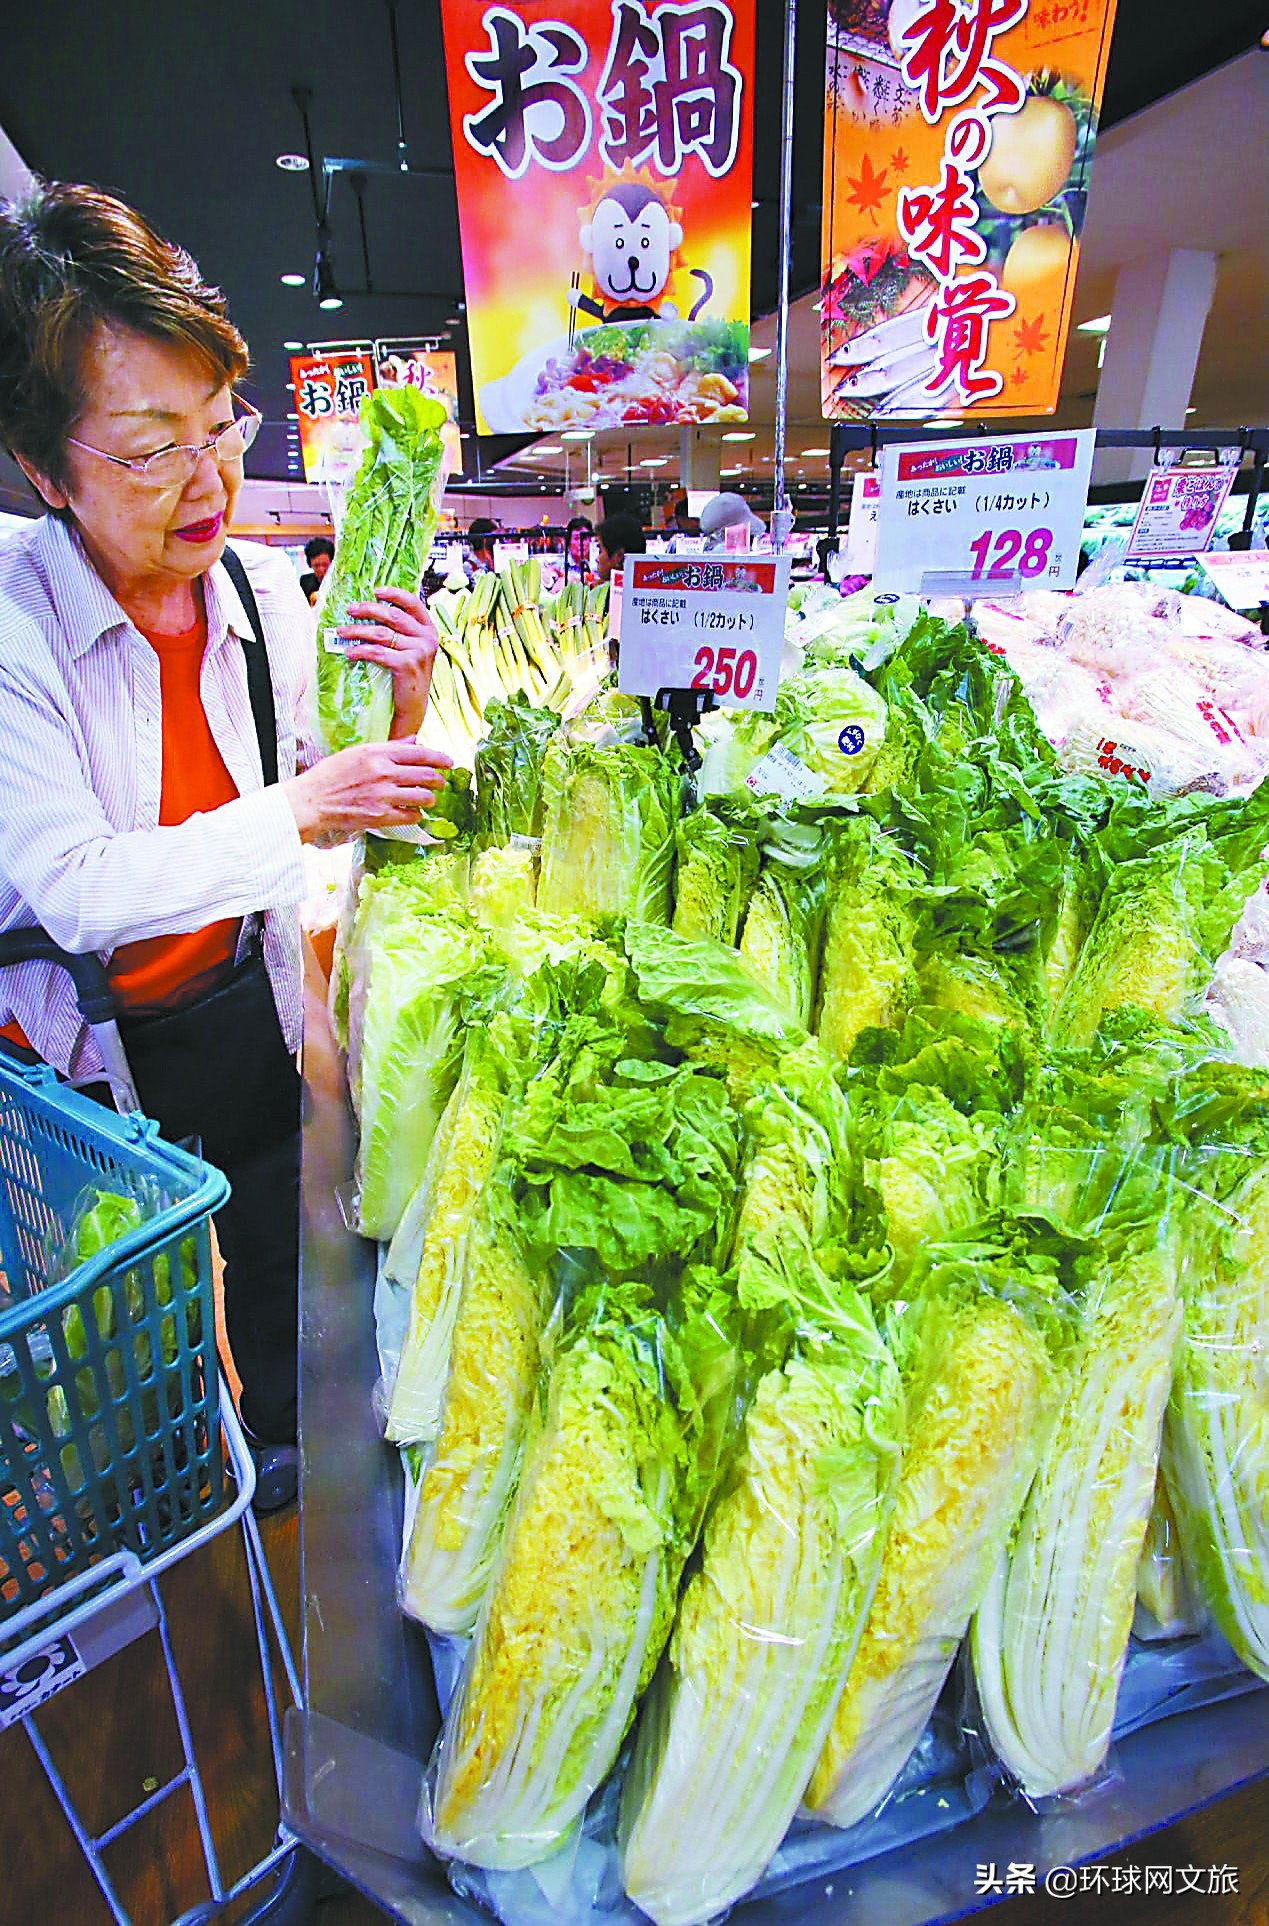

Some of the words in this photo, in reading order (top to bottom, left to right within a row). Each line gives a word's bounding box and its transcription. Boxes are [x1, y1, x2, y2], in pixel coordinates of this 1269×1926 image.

[466, 1, 740, 177] お鍋
[900, 0, 1023, 403] 秋の味覚
[963, 445, 1014, 472] お鍋
[896, 486, 966, 499] 産地は商品に記載
[908, 498, 957, 516] はくさい
[975, 492, 1051, 512] (1/4カット)
[969, 528, 1053, 581] 128
[683, 564, 724, 591] お鍋
[1048, 566, 1060, 577] 円
[631, 597, 687, 609] 産地は商品に記載
[641, 609, 680, 625] はくさい
[694, 612, 755, 631] (1/2カット)
[691, 646, 758, 699] 250
[753, 688, 764, 701] 円
